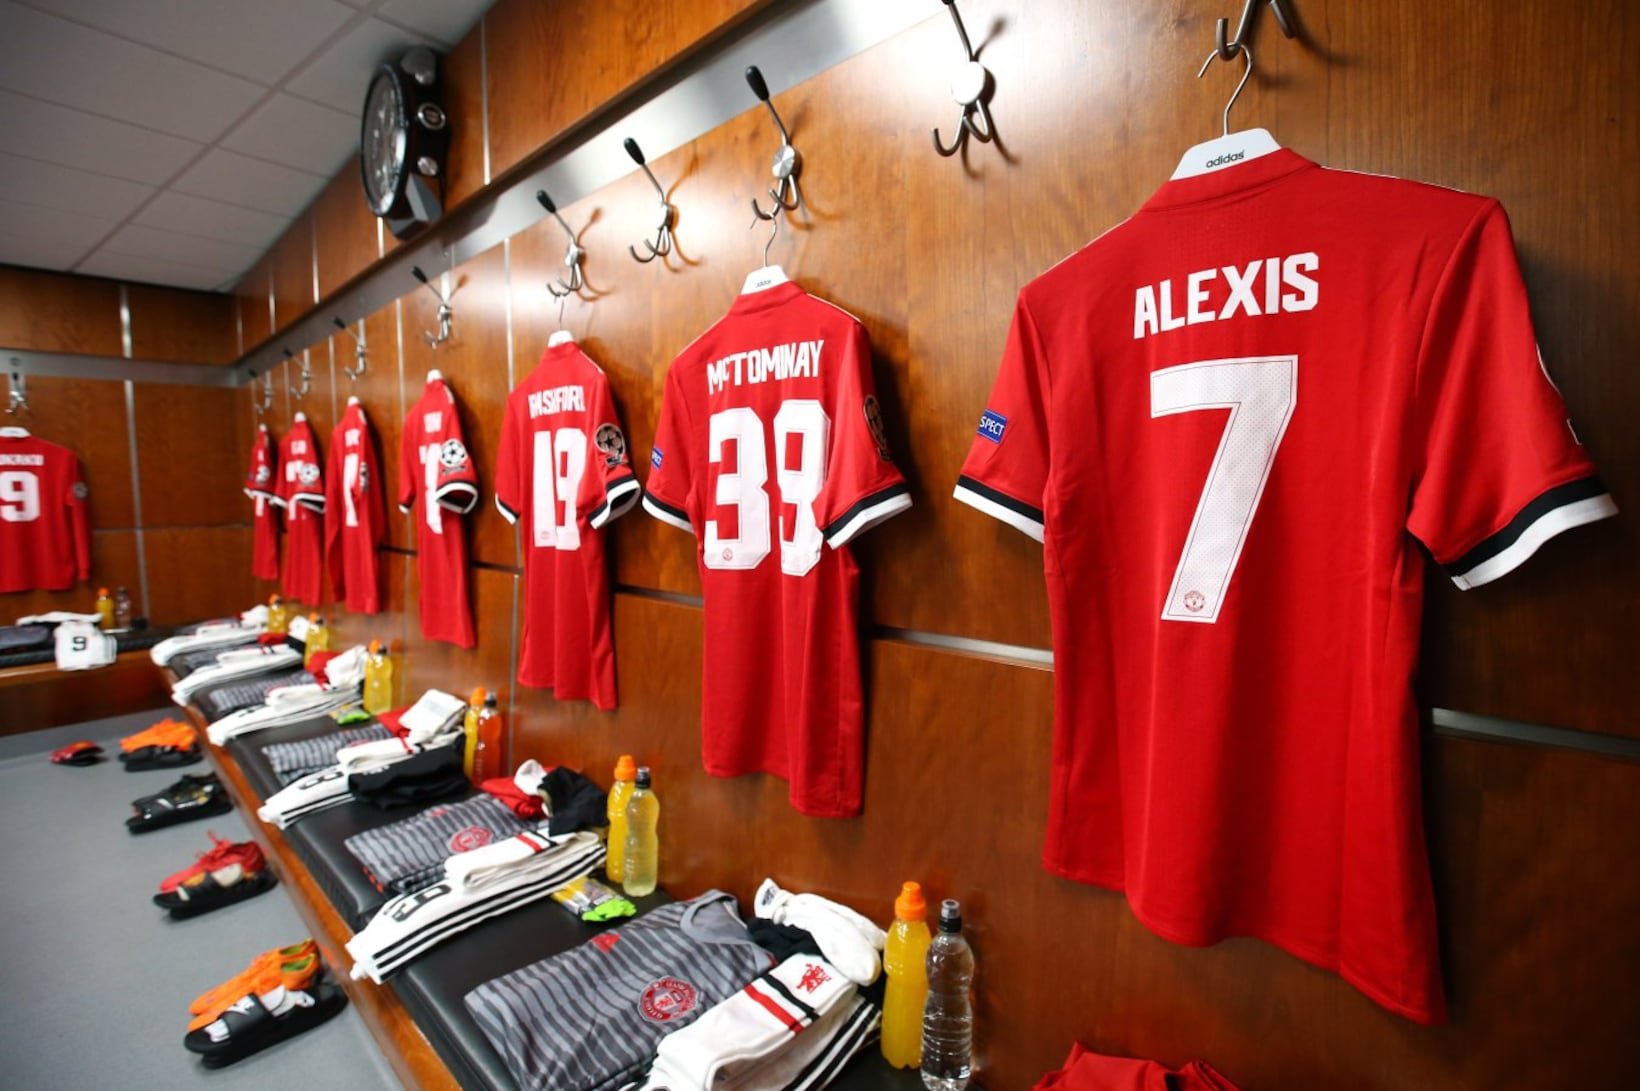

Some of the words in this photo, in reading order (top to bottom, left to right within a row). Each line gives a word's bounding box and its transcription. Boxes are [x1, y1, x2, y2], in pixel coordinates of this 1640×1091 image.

[1206, 151, 1244, 168] adidas
[1134, 252, 1320, 340] ALEXIS
[979, 415, 1005, 436] SPECT
[0, 470, 40, 522] 9
[533, 428, 587, 550] 19
[704, 399, 831, 576] 39
[1150, 354, 1298, 623] 7
[72, 636, 87, 651] 9
